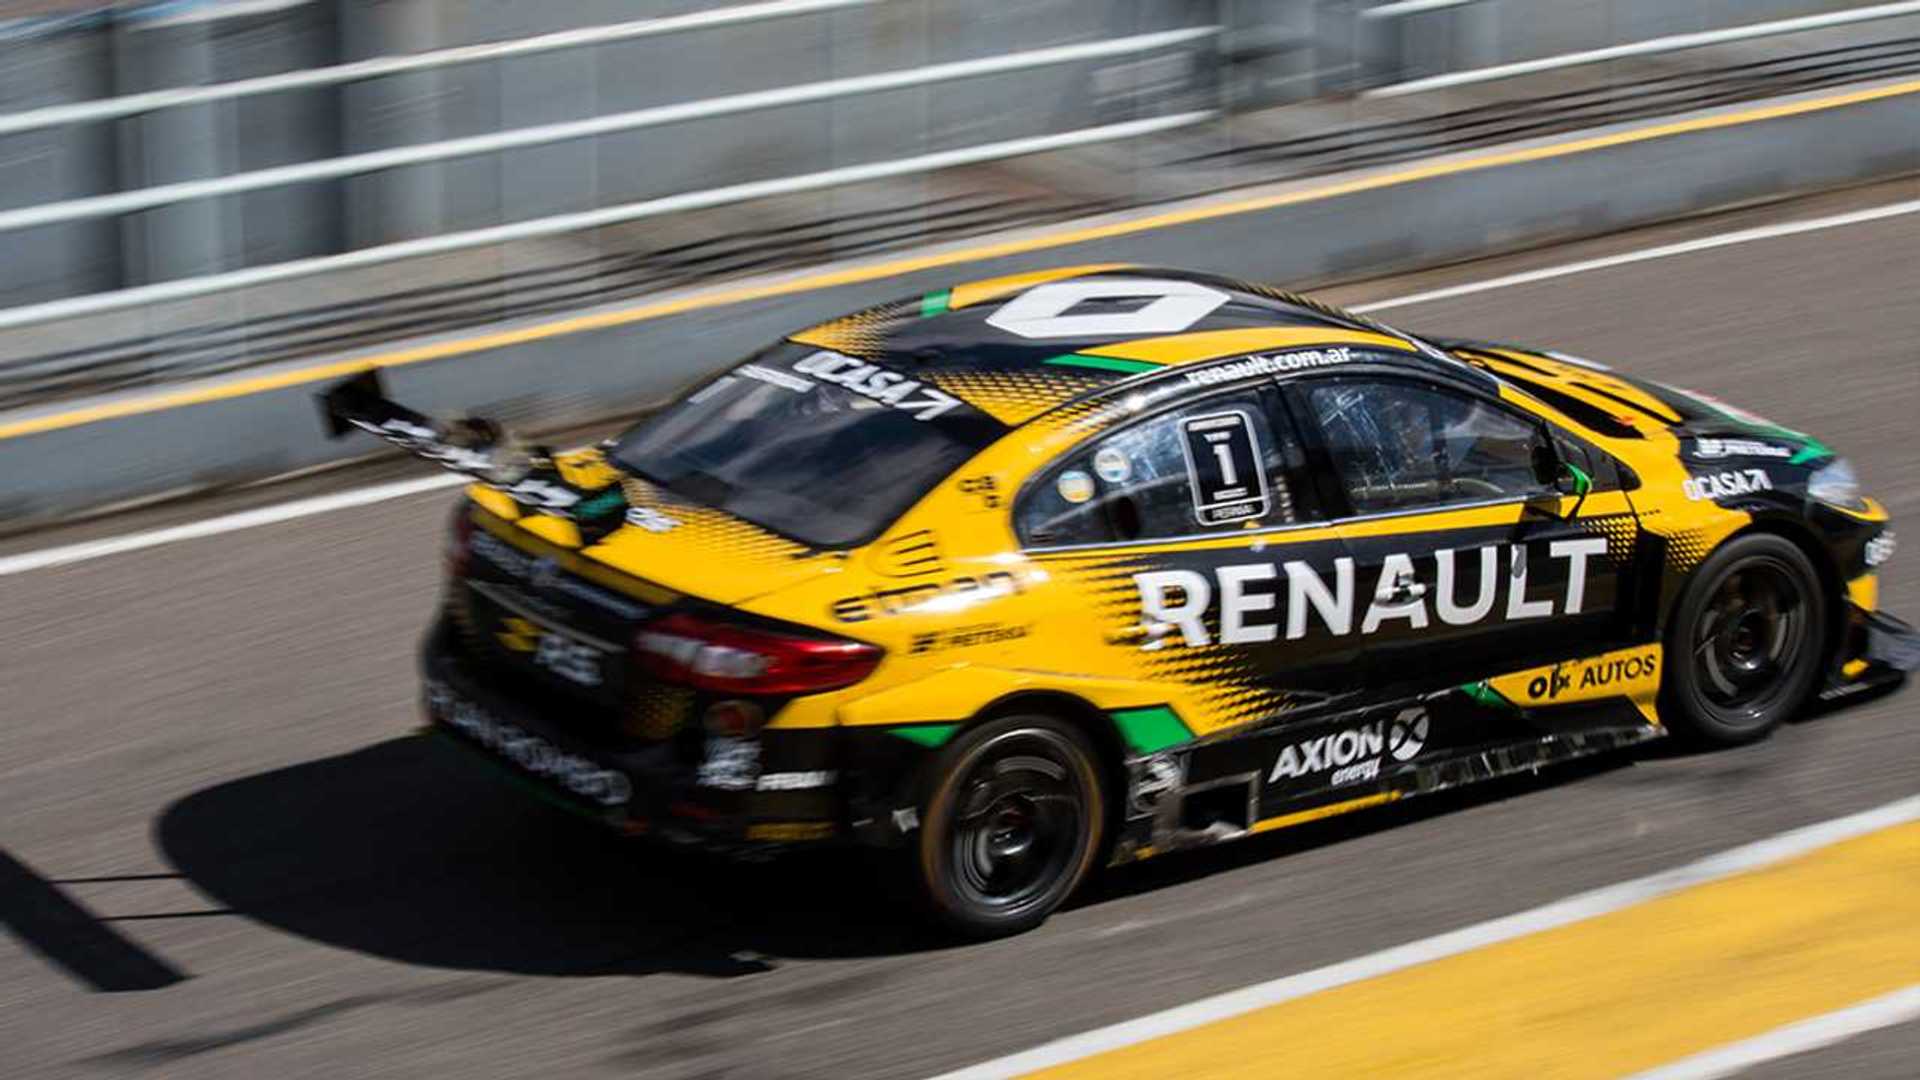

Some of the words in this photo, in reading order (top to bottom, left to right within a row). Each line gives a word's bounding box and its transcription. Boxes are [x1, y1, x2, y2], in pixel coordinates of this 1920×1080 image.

[1185, 347, 1350, 385] renault.com.ar
[1213, 443, 1238, 486] 1
[1133, 538, 1608, 651] RENAULT
[1580, 653, 1656, 689] AUTOS
[1268, 720, 1384, 784] AXION
